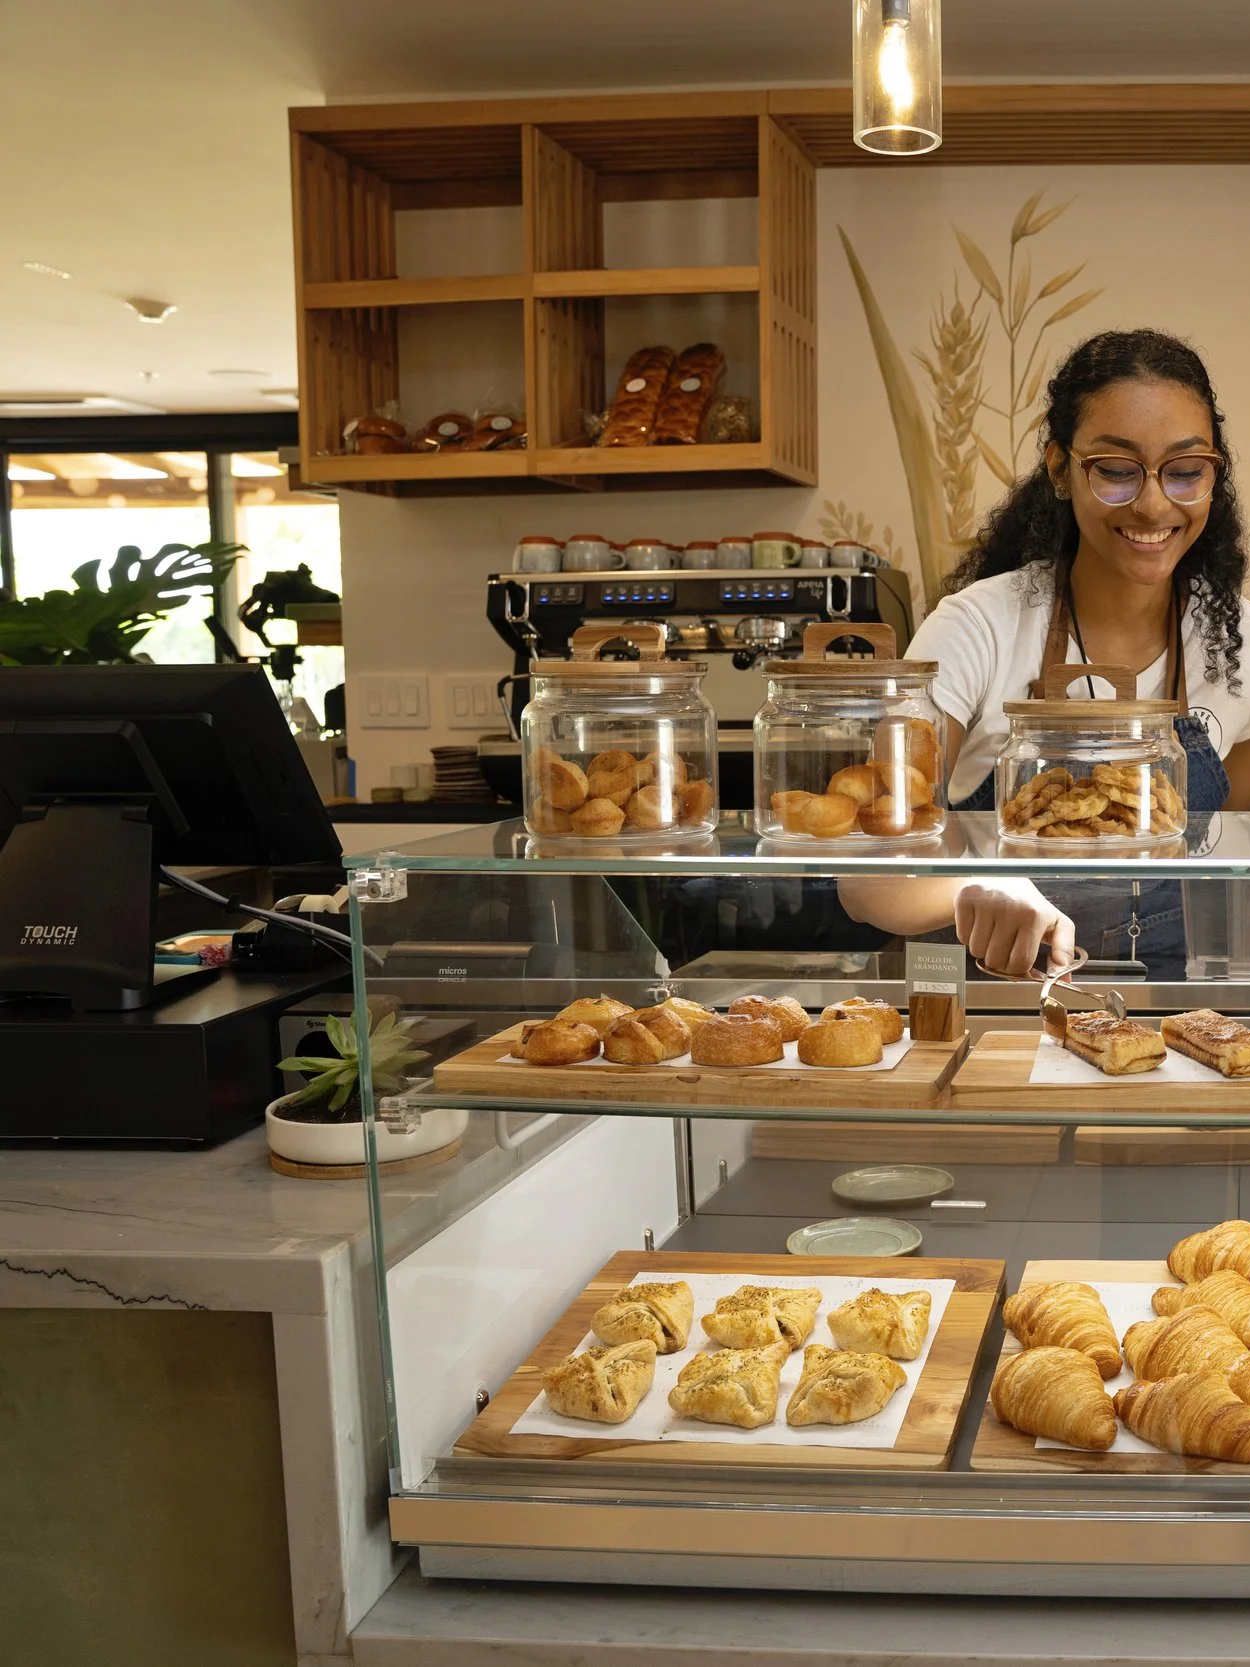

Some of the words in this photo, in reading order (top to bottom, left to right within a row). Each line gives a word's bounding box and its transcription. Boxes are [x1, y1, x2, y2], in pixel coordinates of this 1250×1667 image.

[24, 925, 78, 938] TOUCH
[917, 956, 942, 964] ROLLO
[438, 967, 467, 975] micros
